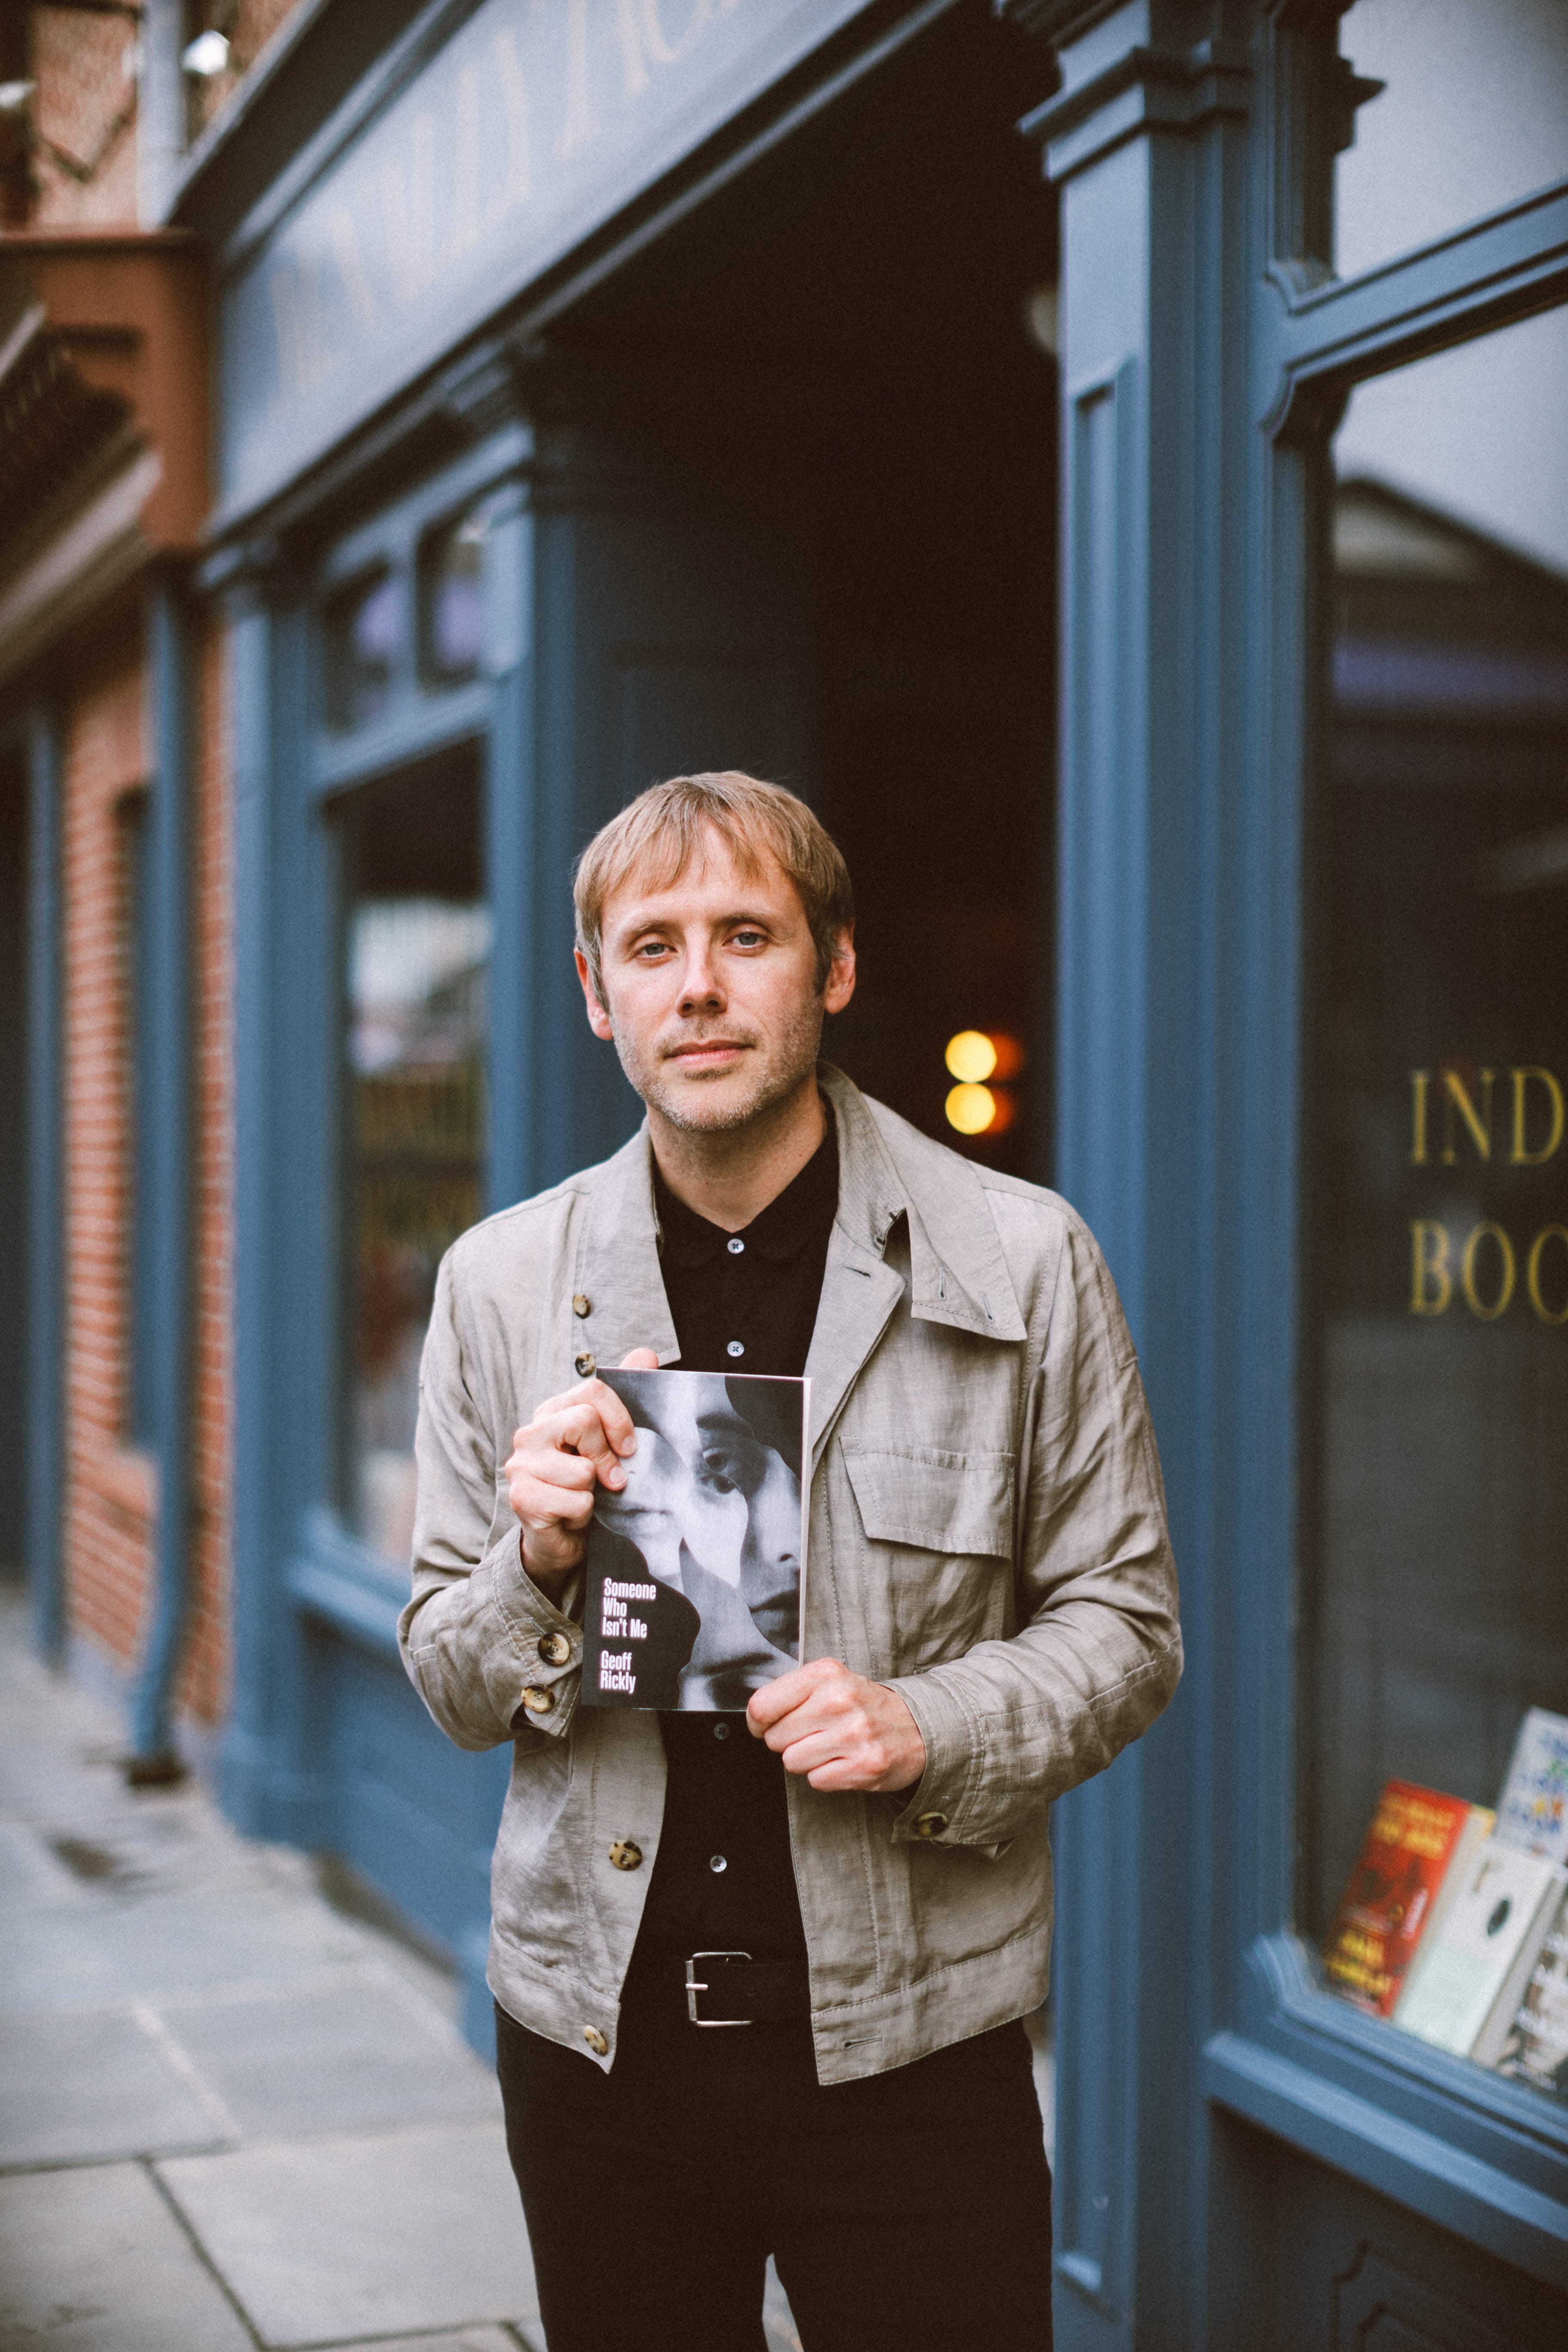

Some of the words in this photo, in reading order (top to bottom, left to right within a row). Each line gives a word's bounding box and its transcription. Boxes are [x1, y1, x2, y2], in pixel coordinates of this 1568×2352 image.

[603, 1577, 657, 1600] Someone
[603, 1597, 628, 1617] Who
[602, 1616, 628, 1637] Isn't
[630, 1618, 647, 1638] Me
[600, 1650, 632, 1670] Geoff
[600, 1669, 636, 1694] Rickly
